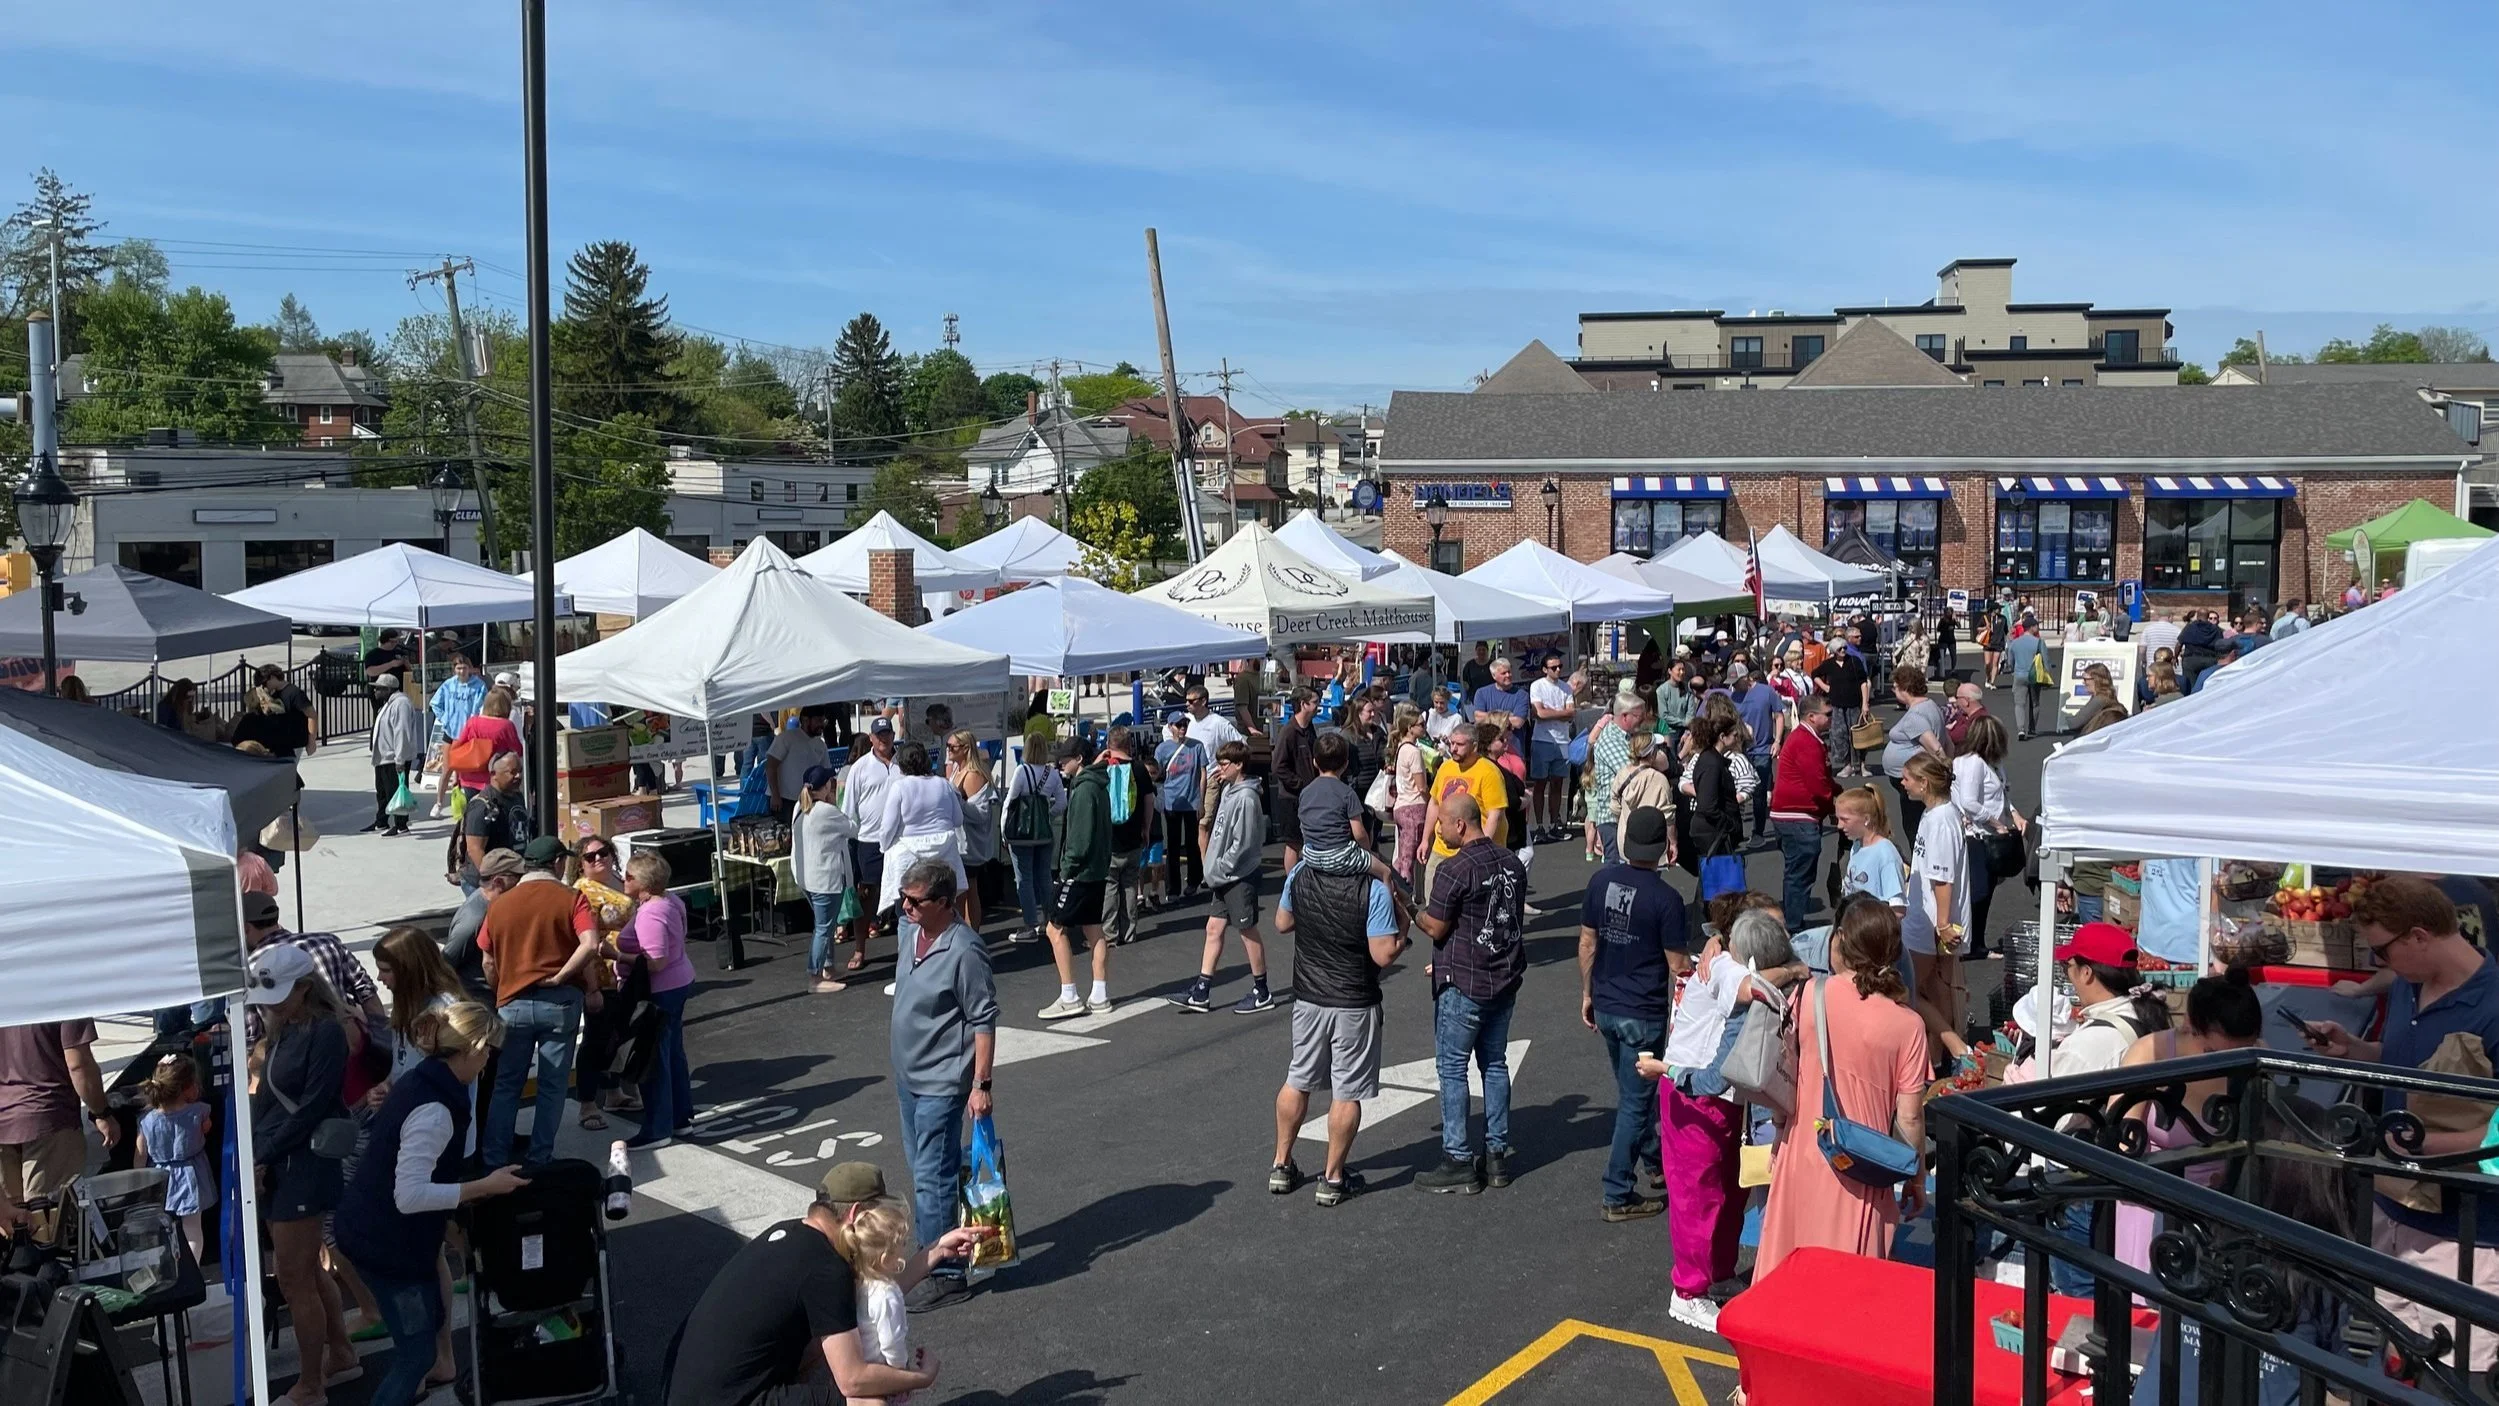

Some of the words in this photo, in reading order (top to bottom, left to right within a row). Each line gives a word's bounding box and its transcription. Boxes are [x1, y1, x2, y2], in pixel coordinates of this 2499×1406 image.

[1276, 613, 1311, 634] Deer
[1316, 609, 1357, 632] Creek
[1363, 606, 1431, 627] Malthouse
